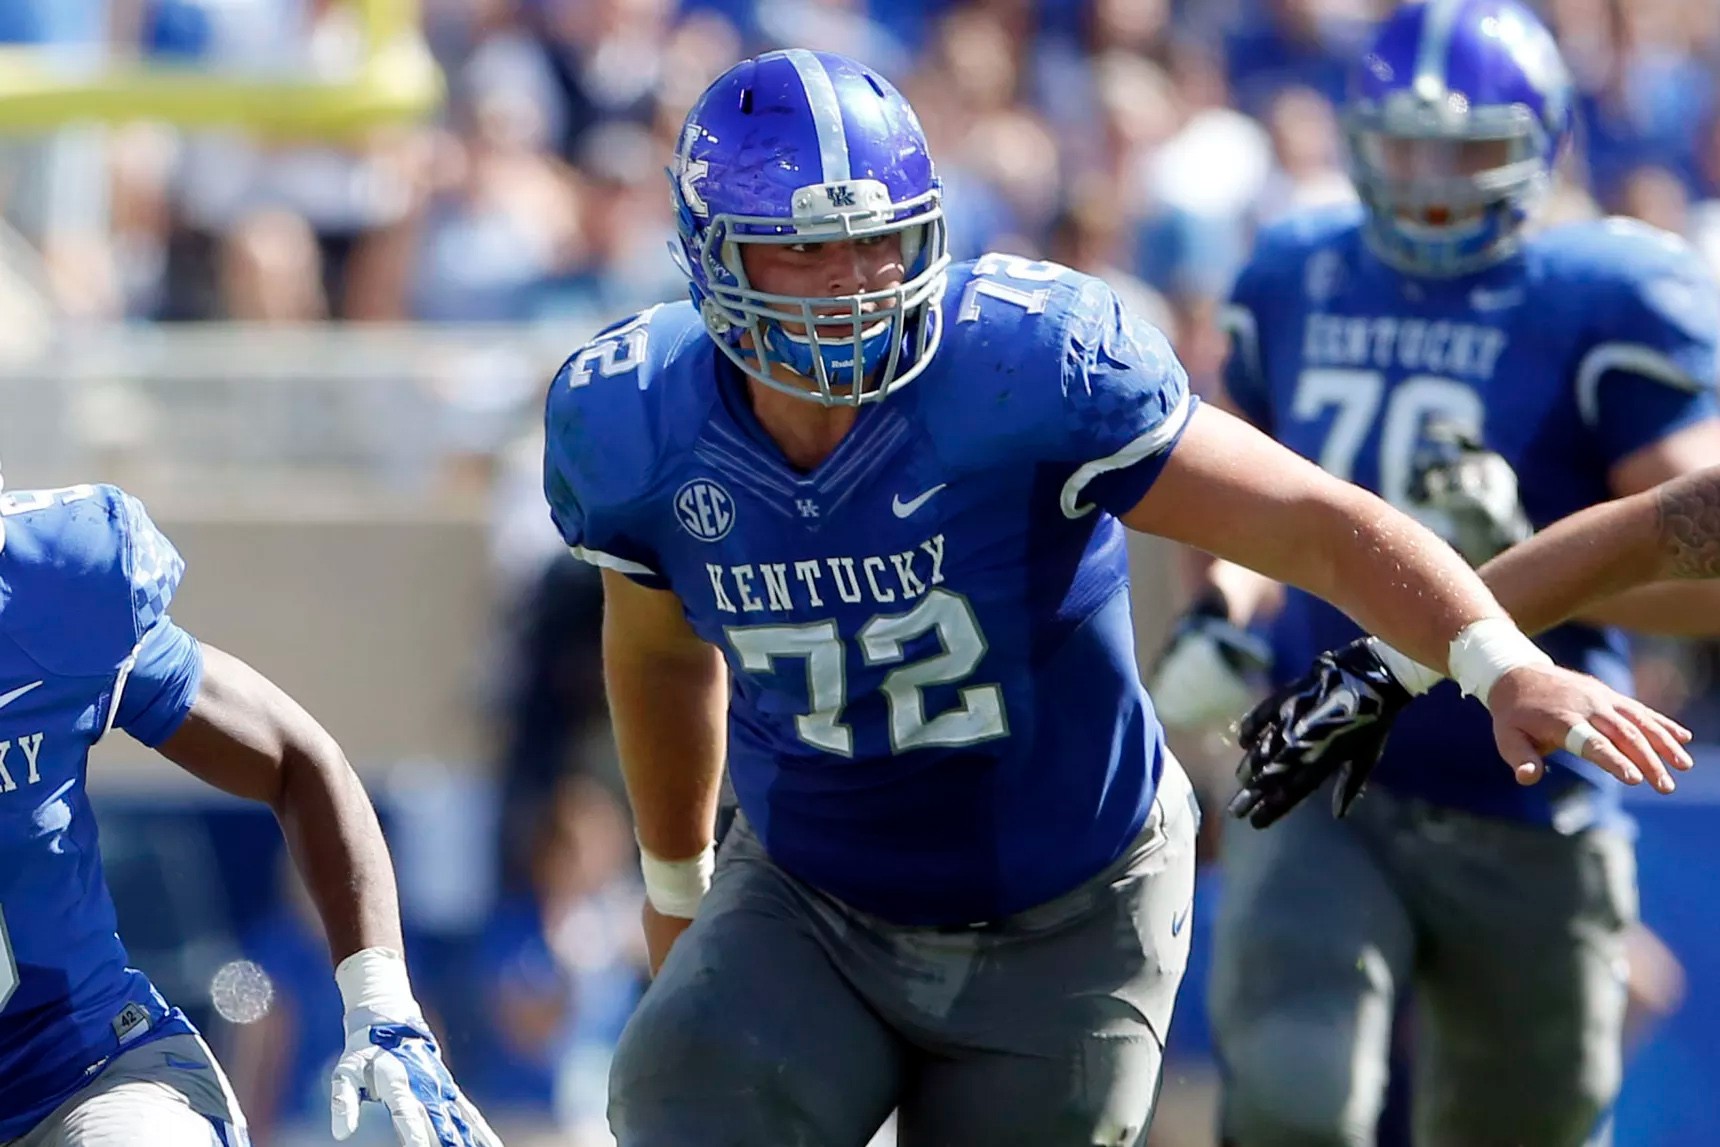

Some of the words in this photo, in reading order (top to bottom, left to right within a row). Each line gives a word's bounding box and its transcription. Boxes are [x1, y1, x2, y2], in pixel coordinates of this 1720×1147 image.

[826, 186, 856, 207] UK
[956, 252, 1062, 326] 72
[678, 483, 732, 537] SEC
[706, 534, 946, 614] KENTUCKY
[722, 587, 1011, 758] 72
[121, 1010, 137, 1028] 42
